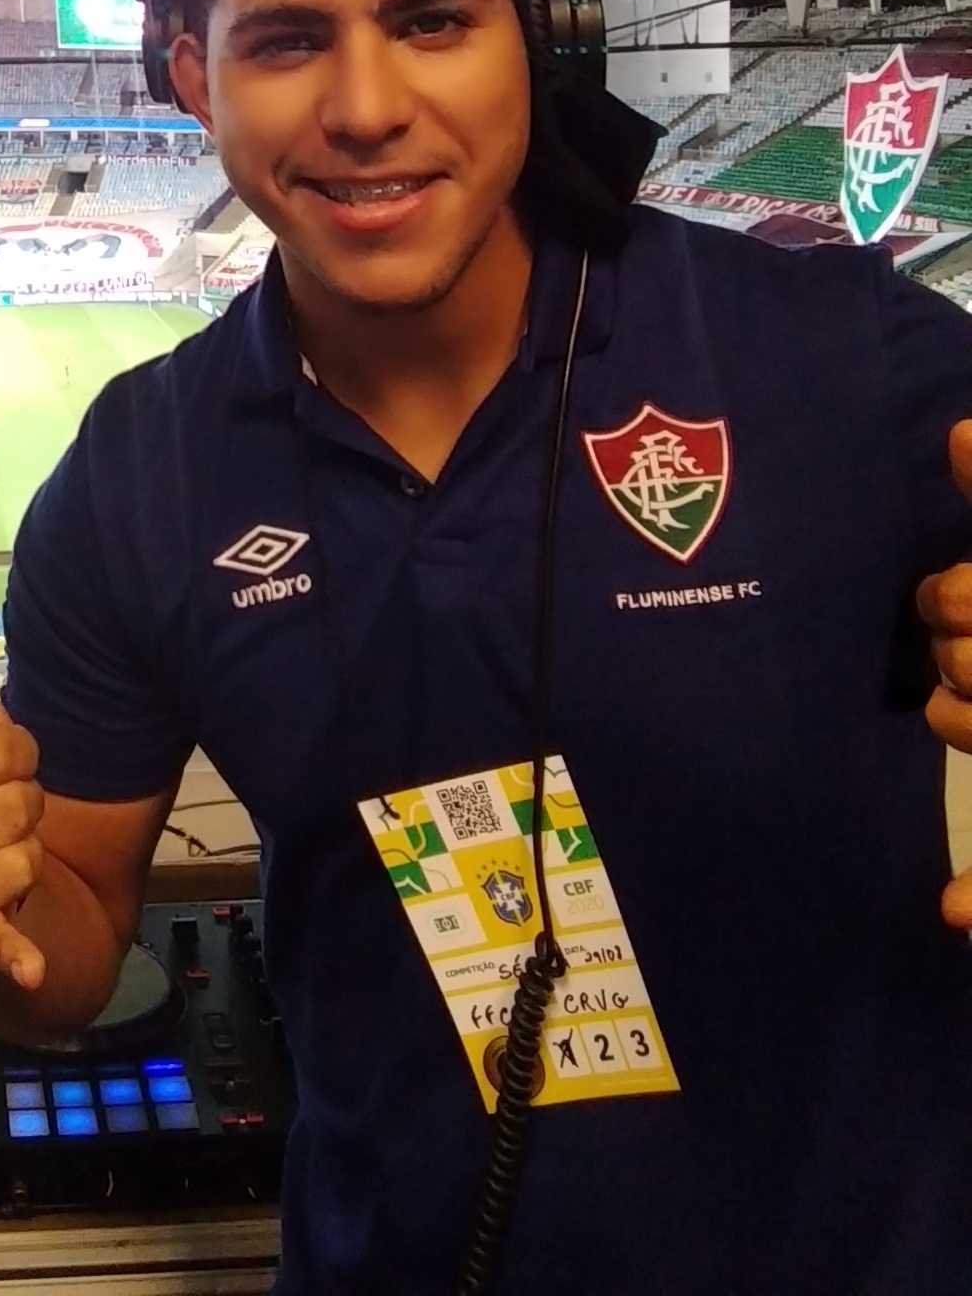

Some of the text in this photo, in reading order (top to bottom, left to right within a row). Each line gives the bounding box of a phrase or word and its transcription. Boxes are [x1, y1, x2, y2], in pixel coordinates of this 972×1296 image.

[231, 573, 313, 609] umbro
[616, 581, 763, 610] FLUMINENSE FC
[563, 878, 594, 897] CBF
[593, 1034, 616, 1062] 2
[629, 1029, 650, 1057] 3
